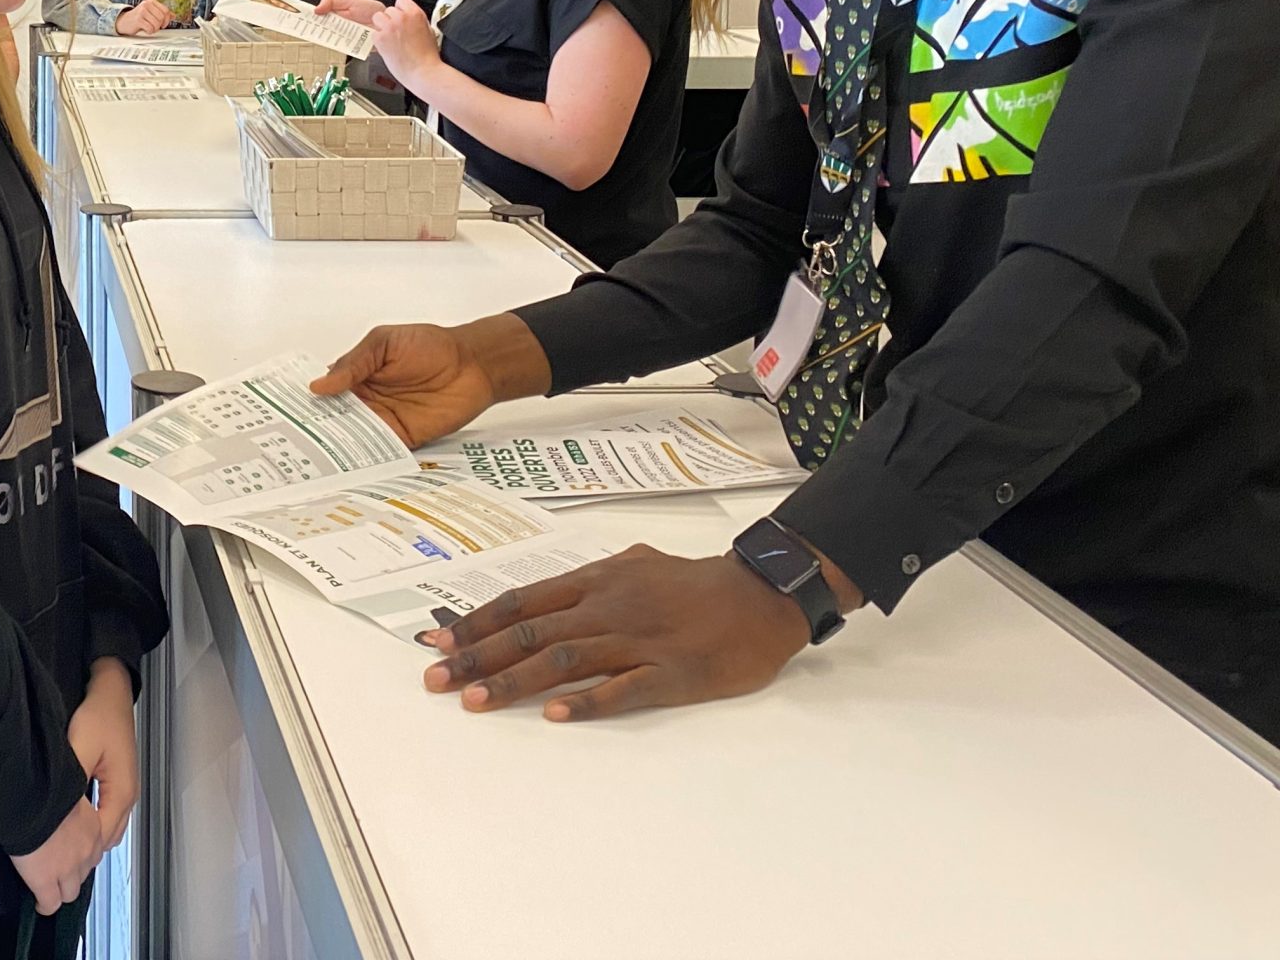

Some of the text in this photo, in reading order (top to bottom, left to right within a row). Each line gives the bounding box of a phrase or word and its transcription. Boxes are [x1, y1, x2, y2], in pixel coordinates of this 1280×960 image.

[458, 442, 504, 490] OURNÉE
[491, 448, 530, 488] PORTES
[513, 438, 560, 492] OUVERTES
[546, 446, 578, 483] novembre
[231, 522, 293, 549] KIOSQUES
[288, 549, 309, 560] ET
[306, 560, 344, 588] PLAN
[415, 582, 476, 612] CTEUR
